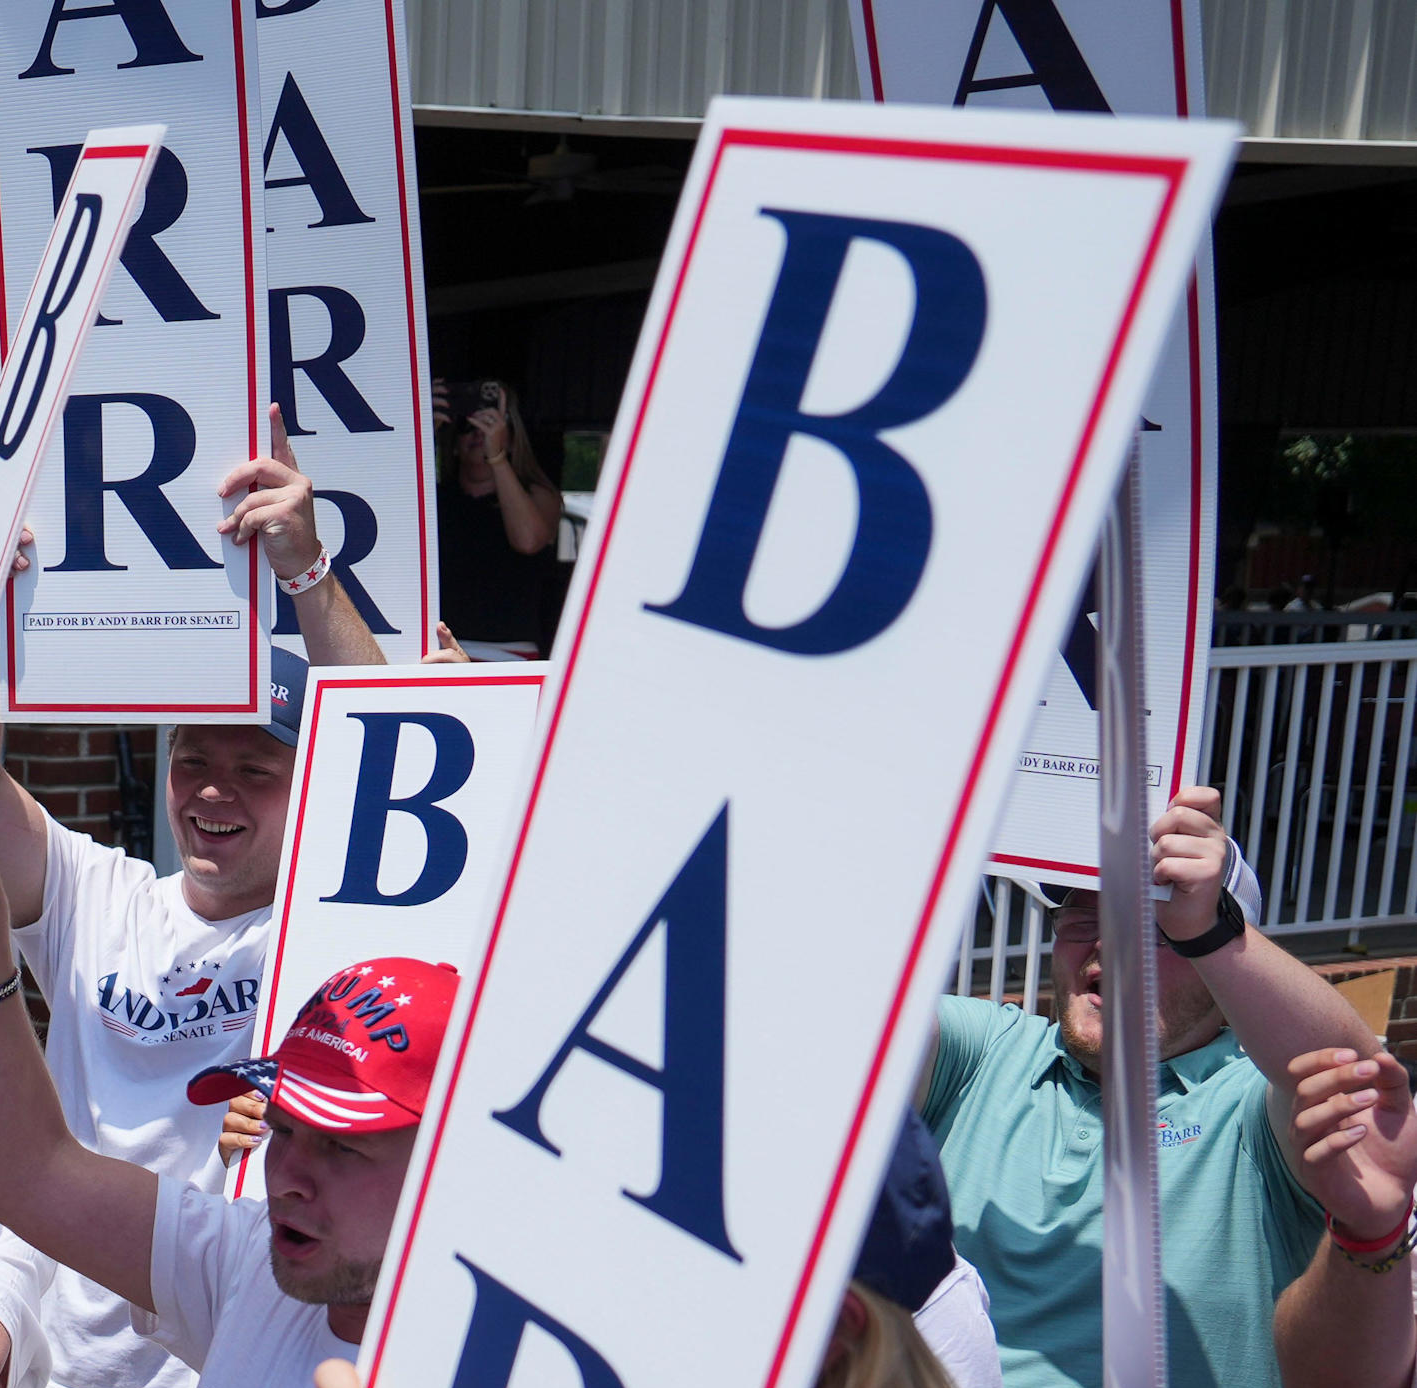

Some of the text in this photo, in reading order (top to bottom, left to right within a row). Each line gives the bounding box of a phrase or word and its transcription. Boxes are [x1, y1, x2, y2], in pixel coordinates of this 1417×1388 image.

[29, 615, 235, 627] PAID FOR BY ANDY BARR FOR SENATE
[1042, 759, 1075, 773] BARR
[161, 1023, 216, 1044] SENATE
